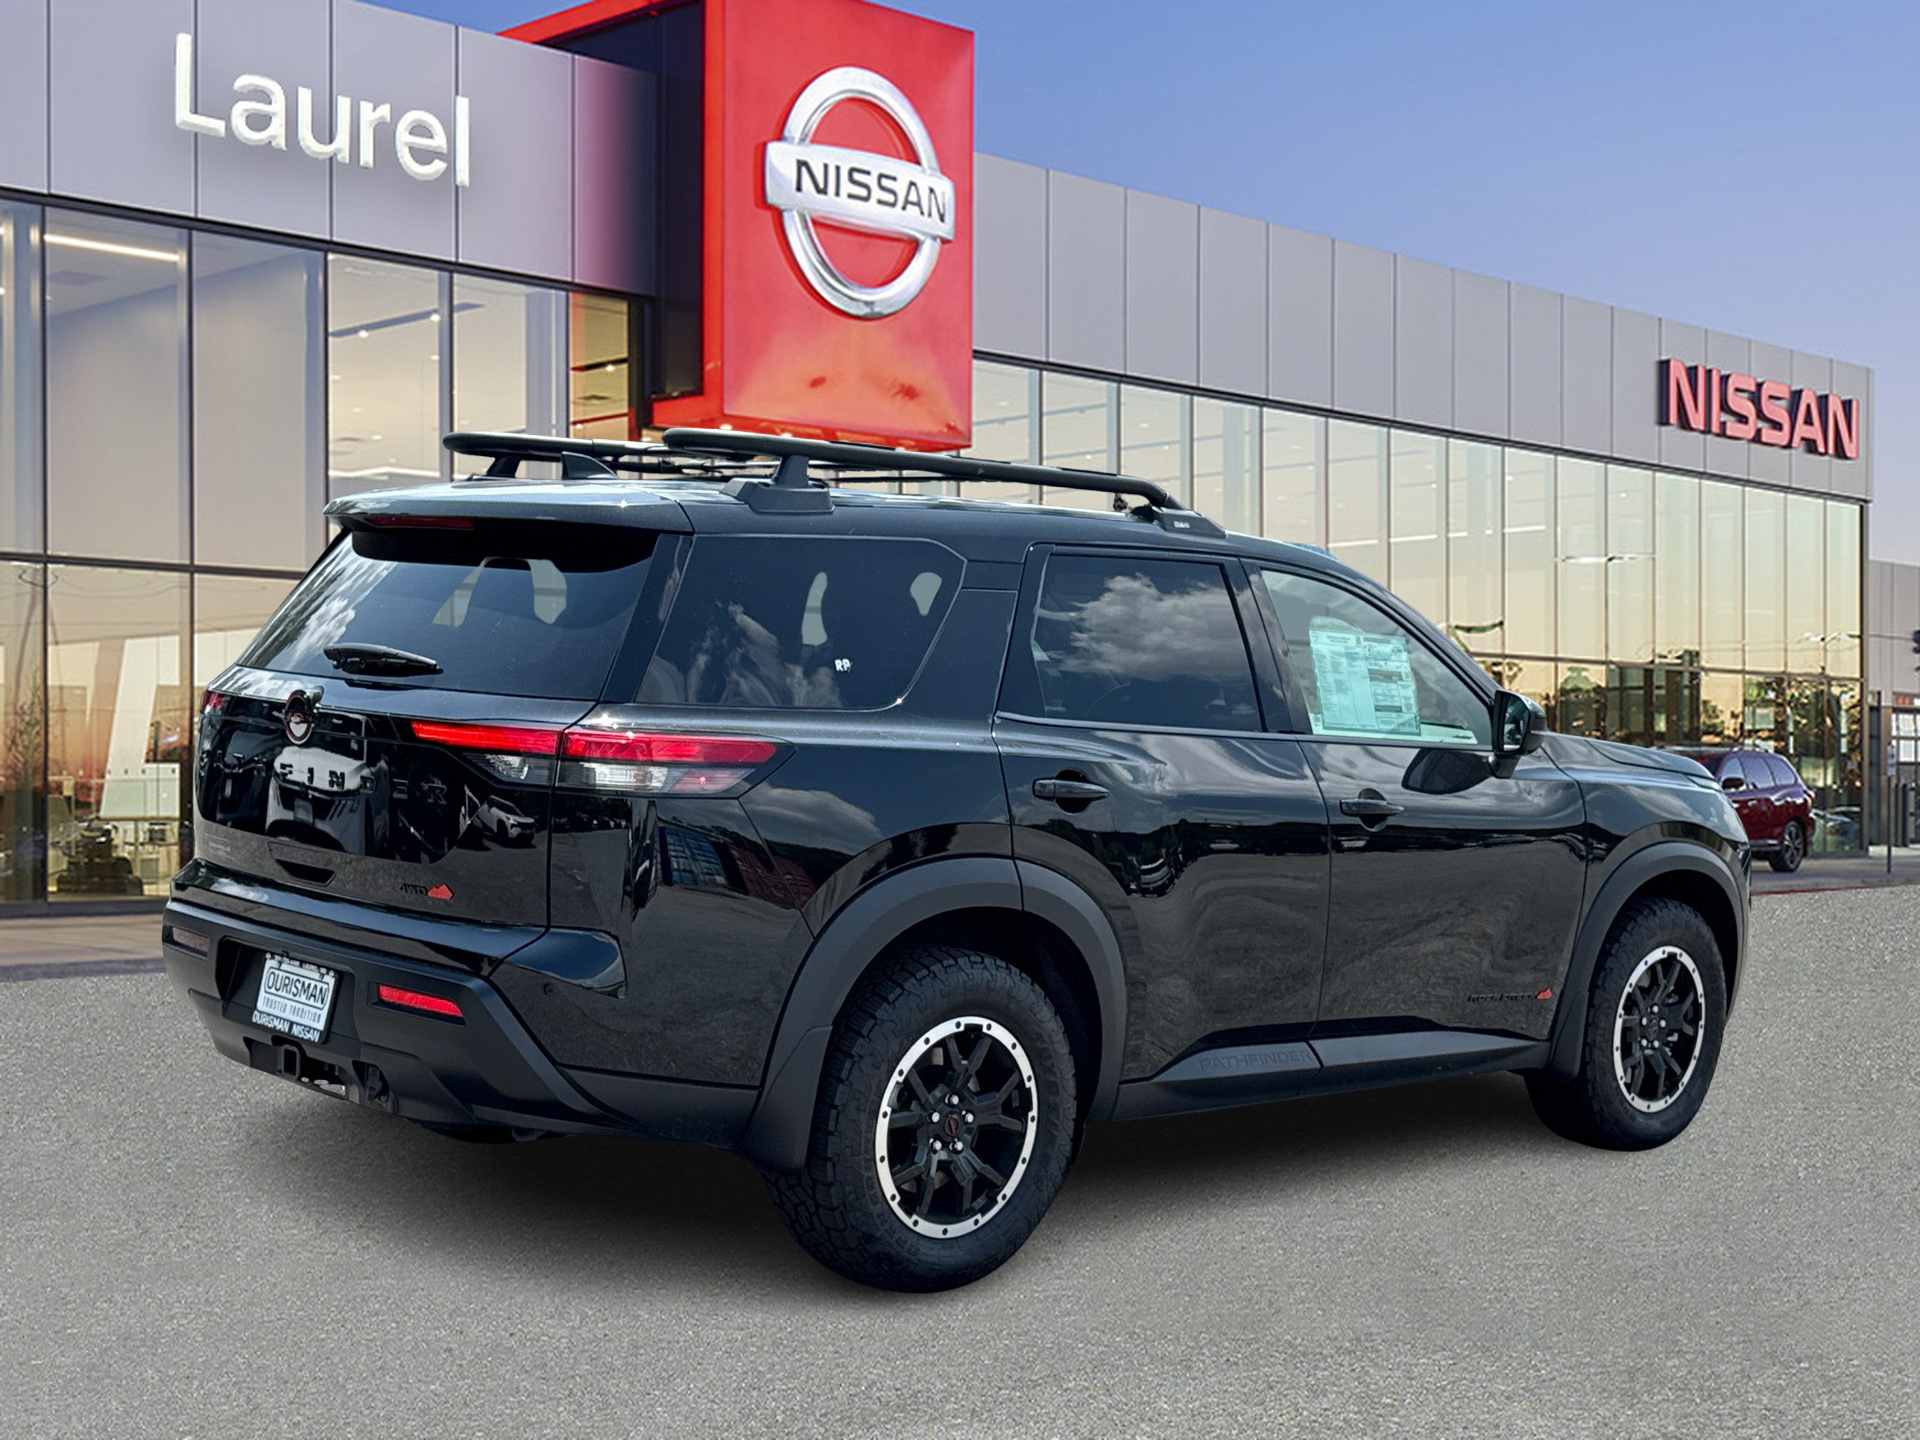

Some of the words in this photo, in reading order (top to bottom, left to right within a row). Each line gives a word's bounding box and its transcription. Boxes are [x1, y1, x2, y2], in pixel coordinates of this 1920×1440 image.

[175, 32, 470, 187] Laurel
[795, 158, 947, 224] NISSAN
[1657, 358, 1860, 460] NISSAN
[267, 971, 327, 1005] OURISMAN
[252, 1010, 290, 1033] OURISMAN
[291, 1023, 320, 1042] NISSAN
[1200, 1050, 1314, 1071] PATHFINDER
